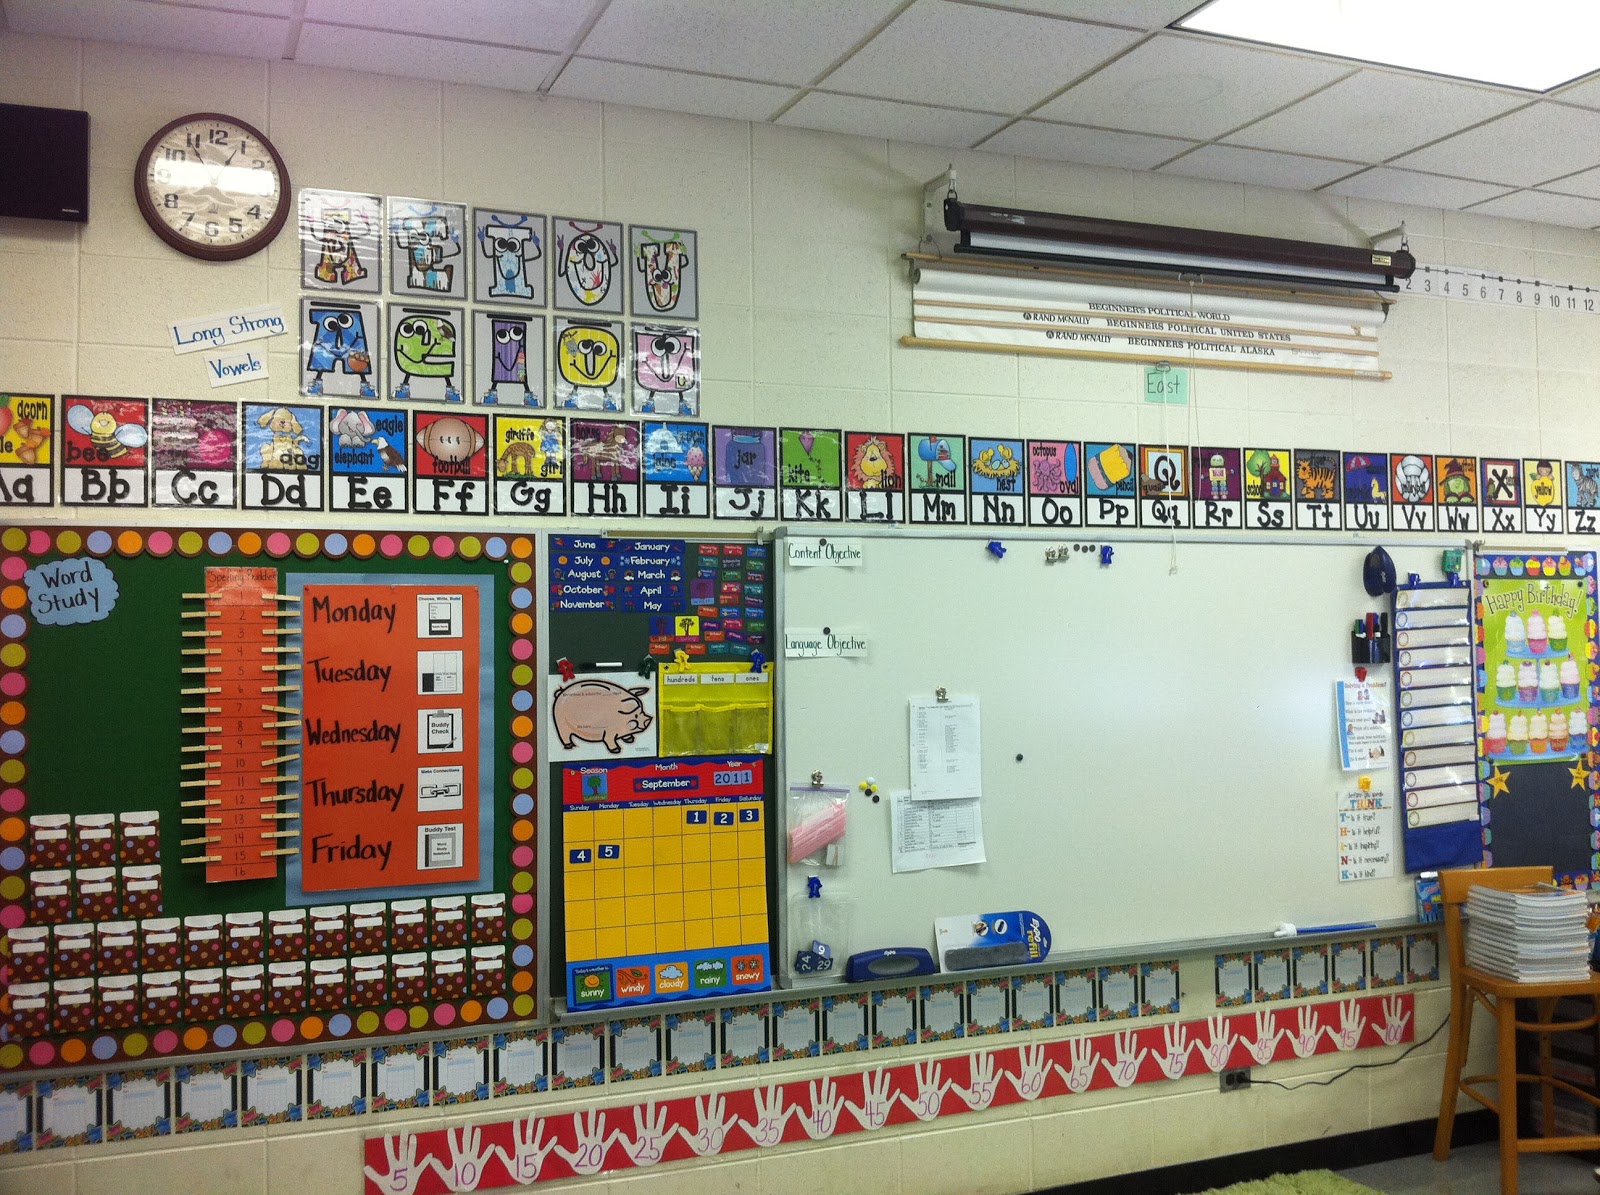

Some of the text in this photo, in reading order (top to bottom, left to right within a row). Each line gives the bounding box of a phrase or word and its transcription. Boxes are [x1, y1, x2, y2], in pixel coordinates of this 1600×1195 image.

[186, 132, 201, 149] 11
[209, 129, 229, 146] 12
[163, 193, 179, 209] 8
[246, 204, 261, 220] 4
[228, 217, 243, 234] 5
[1424, 280, 1594, 312] 3 5 7 9 10 11 12
[1148, 306, 1197, 318] POLITICAL
[1197, 311, 1231, 322] WORLD
[173, 315, 285, 346] Long Strong
[1033, 313, 1055, 323] RAND
[1106, 318, 1164, 331] BEGINNERS
[1167, 323, 1217, 336] POLITICAL
[1220, 327, 1255, 339] UNITED
[1257, 331, 1292, 342] STATES
[1055, 331, 1078, 341] RAND
[1127, 336, 1184, 350] BEGINNERS
[1187, 341, 1237, 354] POLITICAL
[1239, 345, 1276, 356] ALASKA
[209, 352, 262, 379] Vowels
[1146, 371, 1181, 395] East
[17, 400, 48, 420] acorn
[375, 415, 404, 436] eagle
[505, 426, 535, 443] giraffe
[333, 448, 375, 466] elephant
[1032, 441, 1057, 458] octopus
[279, 450, 320, 470] dog
[431, 454, 471, 475] football
[540, 462, 564, 478] girl
[733, 450, 758, 470] jar
[787, 463, 811, 483] kite
[880, 469, 901, 489] lion
[935, 470, 957, 488] mail
[80, 467, 130, 504] Bb
[171, 467, 219, 505] Cc
[260, 473, 307, 508] Dd
[347, 475, 392, 510] Ee
[996, 476, 1016, 493] nest
[1059, 478, 1080, 494] oval
[1115, 480, 1135, 493] pencil
[432, 479, 475, 512] Ff
[510, 480, 552, 513] Gg
[587, 482, 627, 515] Hh
[659, 484, 691, 515] Ii
[729, 489, 765, 520] Jj
[795, 489, 832, 519] Kk
[859, 491, 894, 521] Ll
[923, 493, 957, 522] Mm
[982, 495, 1016, 524] Nn
[1041, 497, 1073, 525] Oo
[1099, 498, 1130, 526] Pp
[1151, 499, 1181, 526] Qq
[1204, 501, 1233, 527] Rr
[1257, 501, 1285, 528] Ss
[1306, 503, 1334, 529] Tt
[1353, 503, 1380, 530] Uu
[1401, 504, 1427, 530] Vv
[1446, 506, 1470, 531] Ww
[1491, 507, 1515, 532] Xx
[1533, 507, 1556, 532] Yy
[1574, 508, 1597, 534] Zz
[573, 539, 596, 549] June
[634, 542, 671, 552] January
[788, 542, 822, 559] Content
[825, 542, 861, 564] Objective
[574, 555, 594, 567] July
[630, 556, 671, 567] February
[41, 560, 93, 589] Word
[567, 569, 602, 580] August
[637, 570, 666, 580] March
[563, 584, 603, 595] October
[640, 585, 662, 596] April
[38, 587, 99, 614] Study
[560, 599, 605, 610] November
[643, 601, 663, 612] May
[1485, 583, 1583, 620] Happy Birthday!
[312, 595, 396, 634] Monday
[785, 633, 867, 658] Language Objective
[307, 656, 392, 693] Tuesday
[304, 718, 401, 753] Wednesday
[235, 758, 246, 768] 10
[580, 766, 608, 775] Season
[655, 762, 679, 771] Month
[726, 760, 743, 768] Year
[641, 779, 691, 791] September
[714, 772, 750, 784] 2011
[305, 777, 404, 812] Thursday
[569, 804, 590, 812] Sunday
[628, 801, 650, 809] Tuesday
[715, 796, 732, 804] Friday
[1350, 799, 1383, 809] THINK
[720, 810, 753, 824] 2 3
[234, 832, 245, 844] 14
[234, 850, 246, 861] 15
[311, 832, 393, 871] Friday
[576, 846, 613, 862] 4 5
[234, 866, 246, 877] 16
[802, 954, 812, 971] 24
[816, 960, 831, 970] 29
[659, 979, 684, 990] cloudy
[700, 975, 721, 986] rainy
[735, 971, 760, 982] snowy
[580, 988, 605, 998] sunny
[620, 984, 645, 994] windy
[389, 1023, 1404, 1192] 5 10 15 20 30 40 50 60 70 80 90 100
